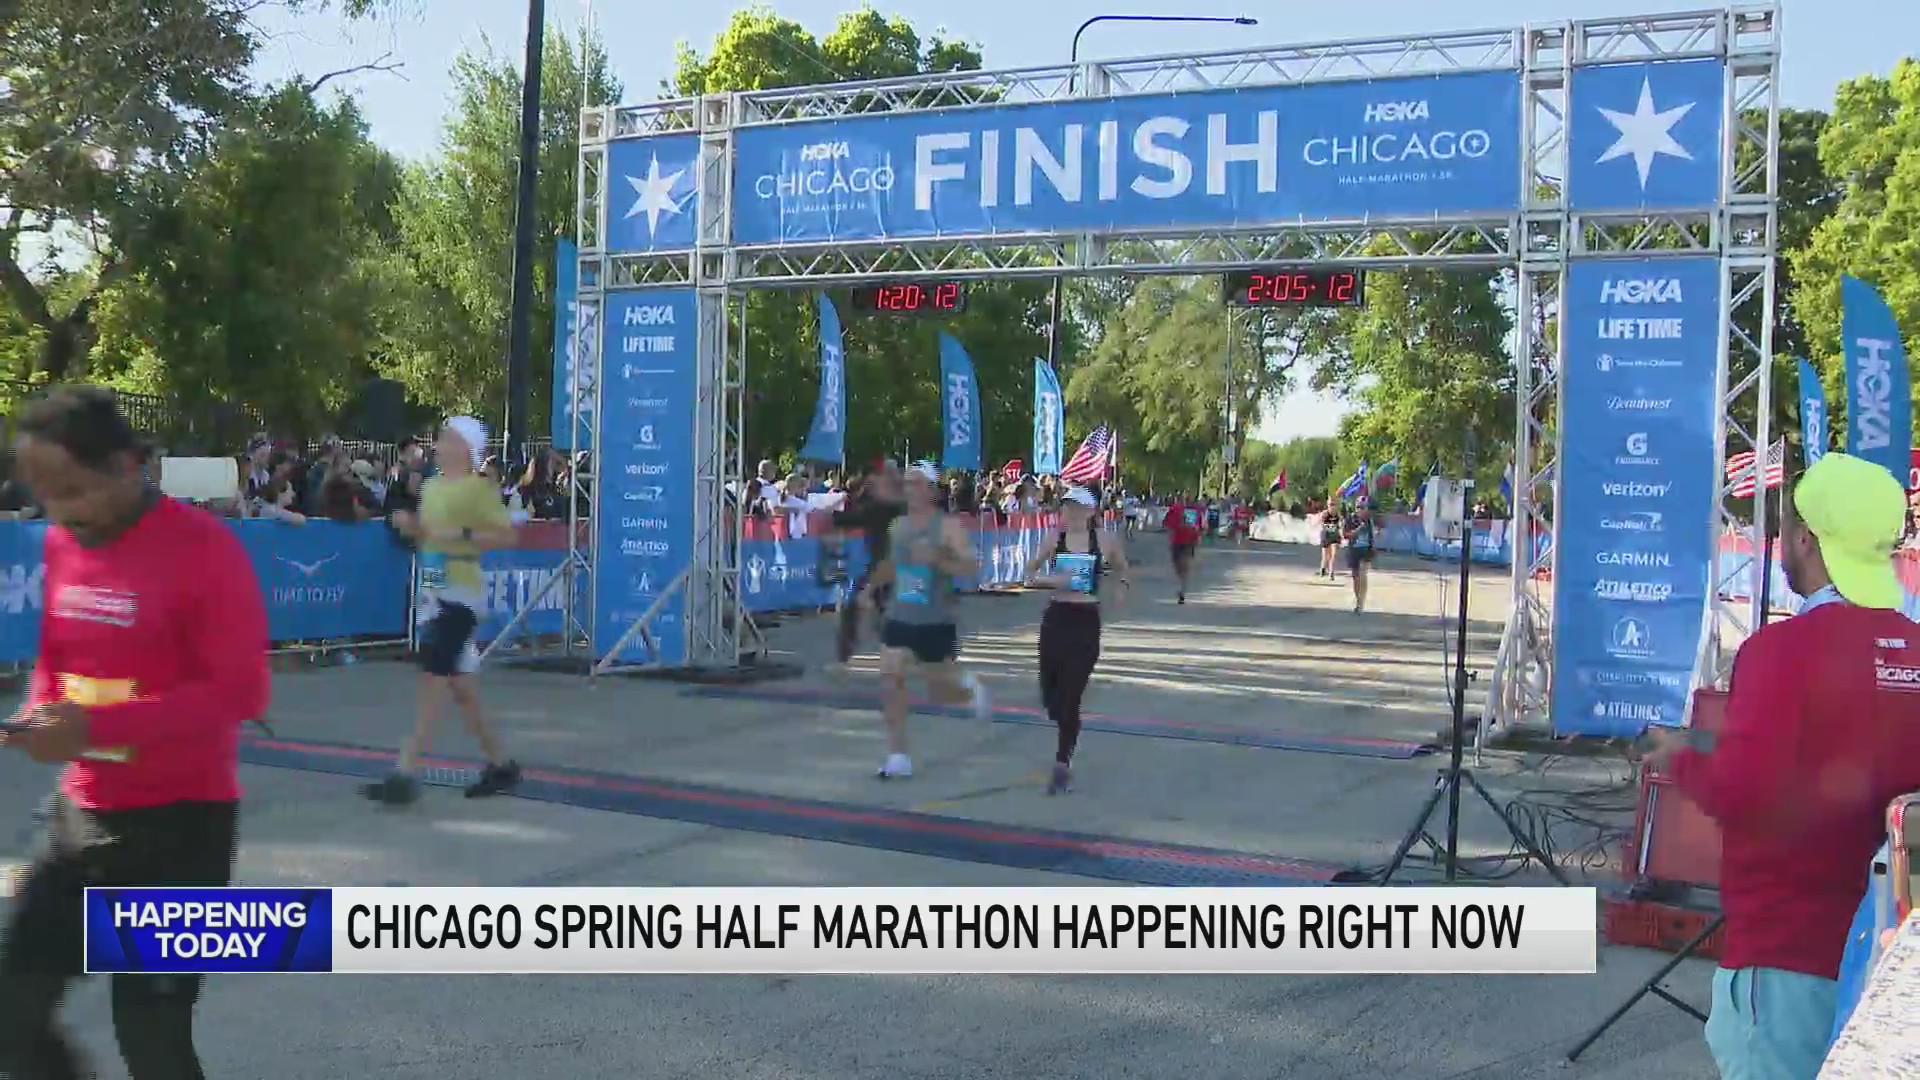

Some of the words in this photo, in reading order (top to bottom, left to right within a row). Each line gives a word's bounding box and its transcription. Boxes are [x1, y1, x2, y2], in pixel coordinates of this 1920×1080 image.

[1364, 100, 1429, 122] HOKA
[914, 110, 1278, 211] FINISH
[1303, 129, 1491, 165] CHICAGO
[755, 167, 894, 199] CHICAGO
[1600, 278, 1683, 304] HOKA
[624, 305, 676, 326] HOKA
[1856, 337, 1892, 451] HOKA
[948, 372, 970, 446] HOKA
[1602, 481, 1665, 497] verizon
[1596, 552, 1670, 567] GARMIN
